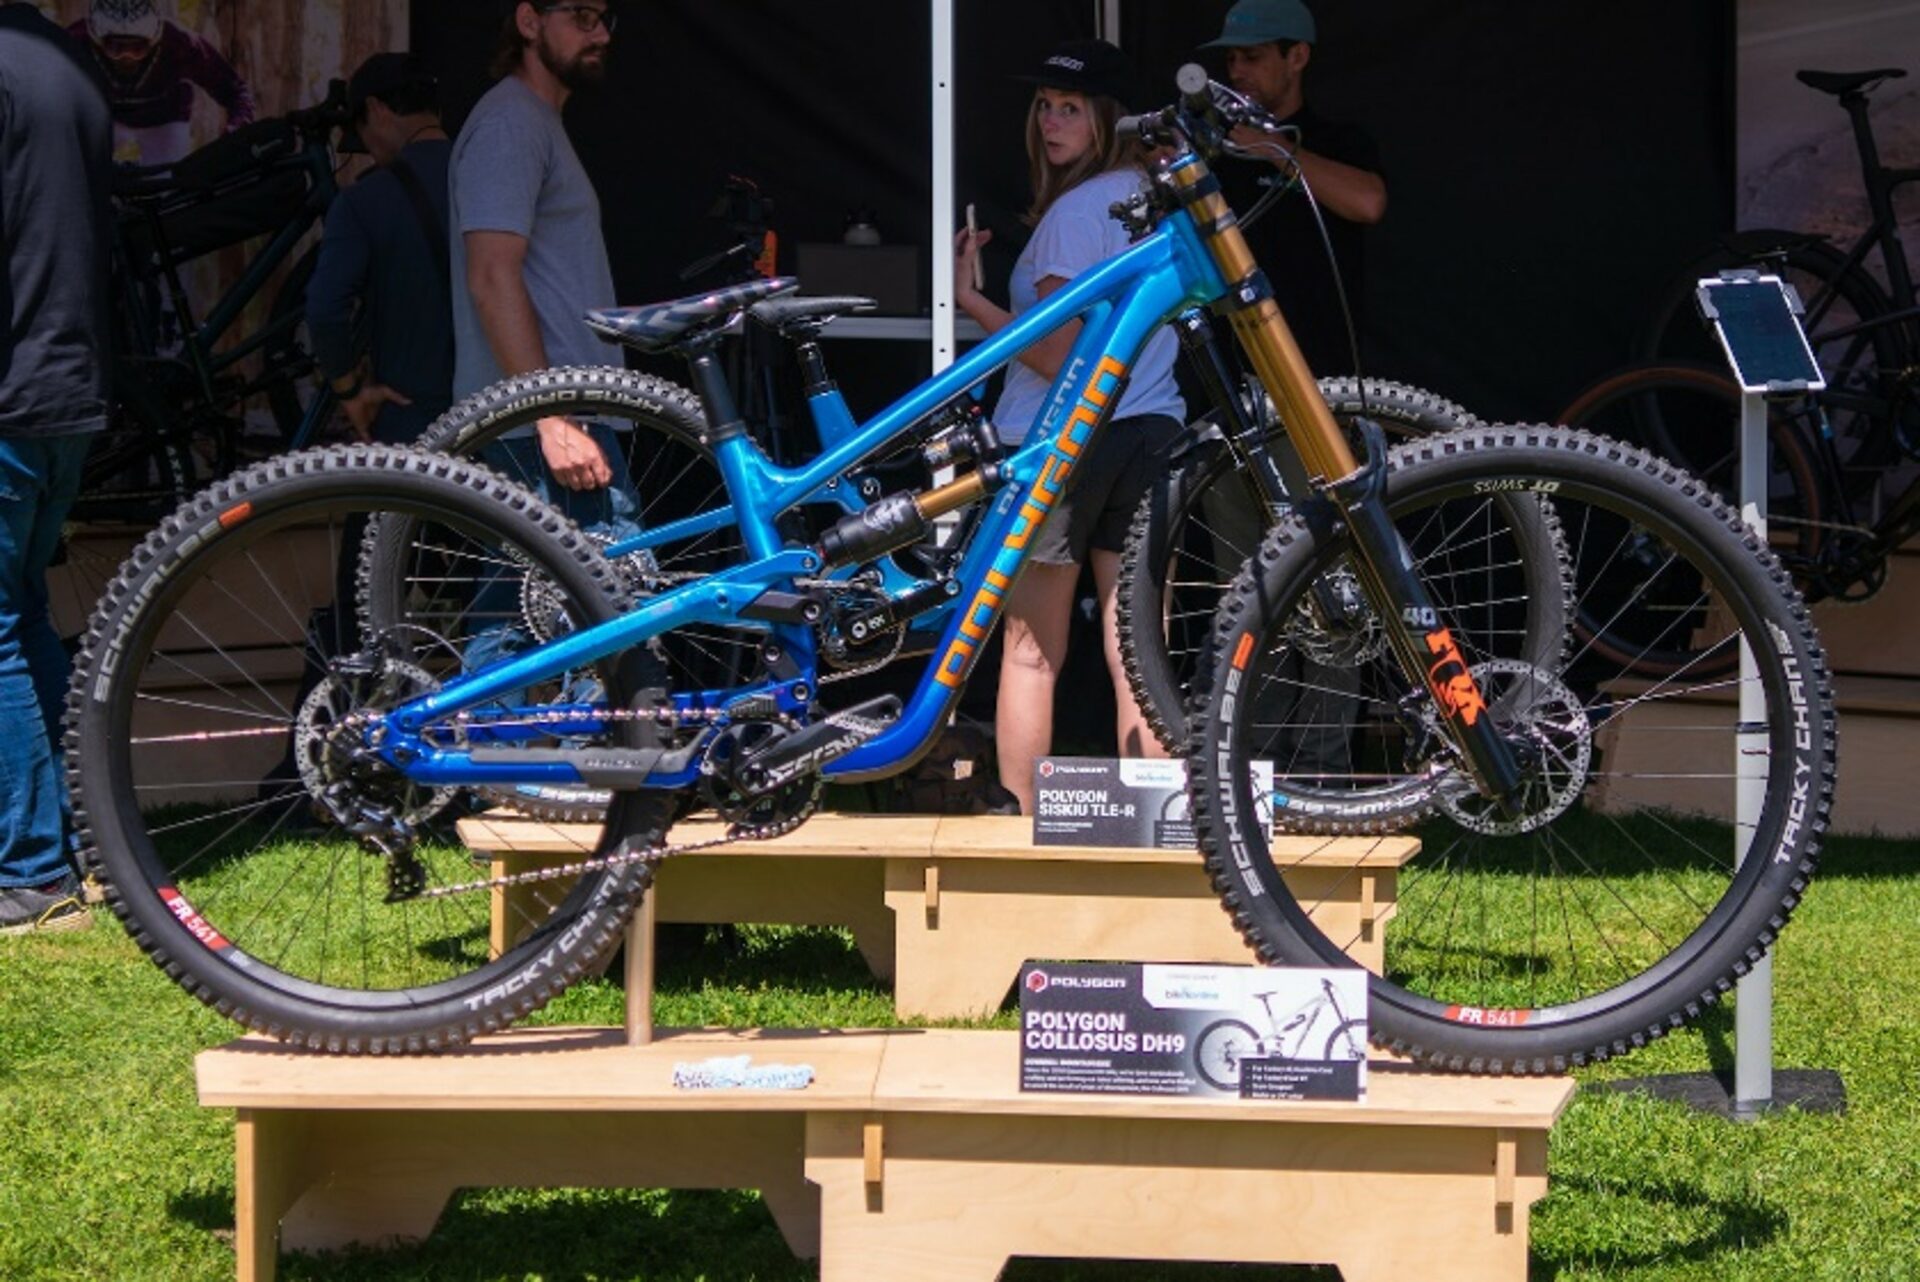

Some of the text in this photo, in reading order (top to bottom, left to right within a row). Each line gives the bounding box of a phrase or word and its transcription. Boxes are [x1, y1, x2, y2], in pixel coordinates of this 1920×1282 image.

[1473, 479, 1560, 495] DT SWISS
[93, 517, 221, 703] SCHWALBE
[1402, 606, 1437, 626] 40
[1424, 626, 1487, 727] FOX
[1774, 655, 1812, 865] TACKY CHAN
[1217, 666, 1265, 897] SCHWALBE
[1039, 789, 1107, 803] POLYGON
[1039, 803, 1136, 818] SISKIU TLE-R
[167, 895, 220, 944] FR 541
[463, 948, 555, 1012] TACKY
[1050, 977, 1126, 989] POLYGON
[1025, 1011, 1125, 1032] POLYGON
[1458, 1006, 1517, 1026] FR 541
[1025, 1031, 1186, 1054] COLLOSUS DH9
